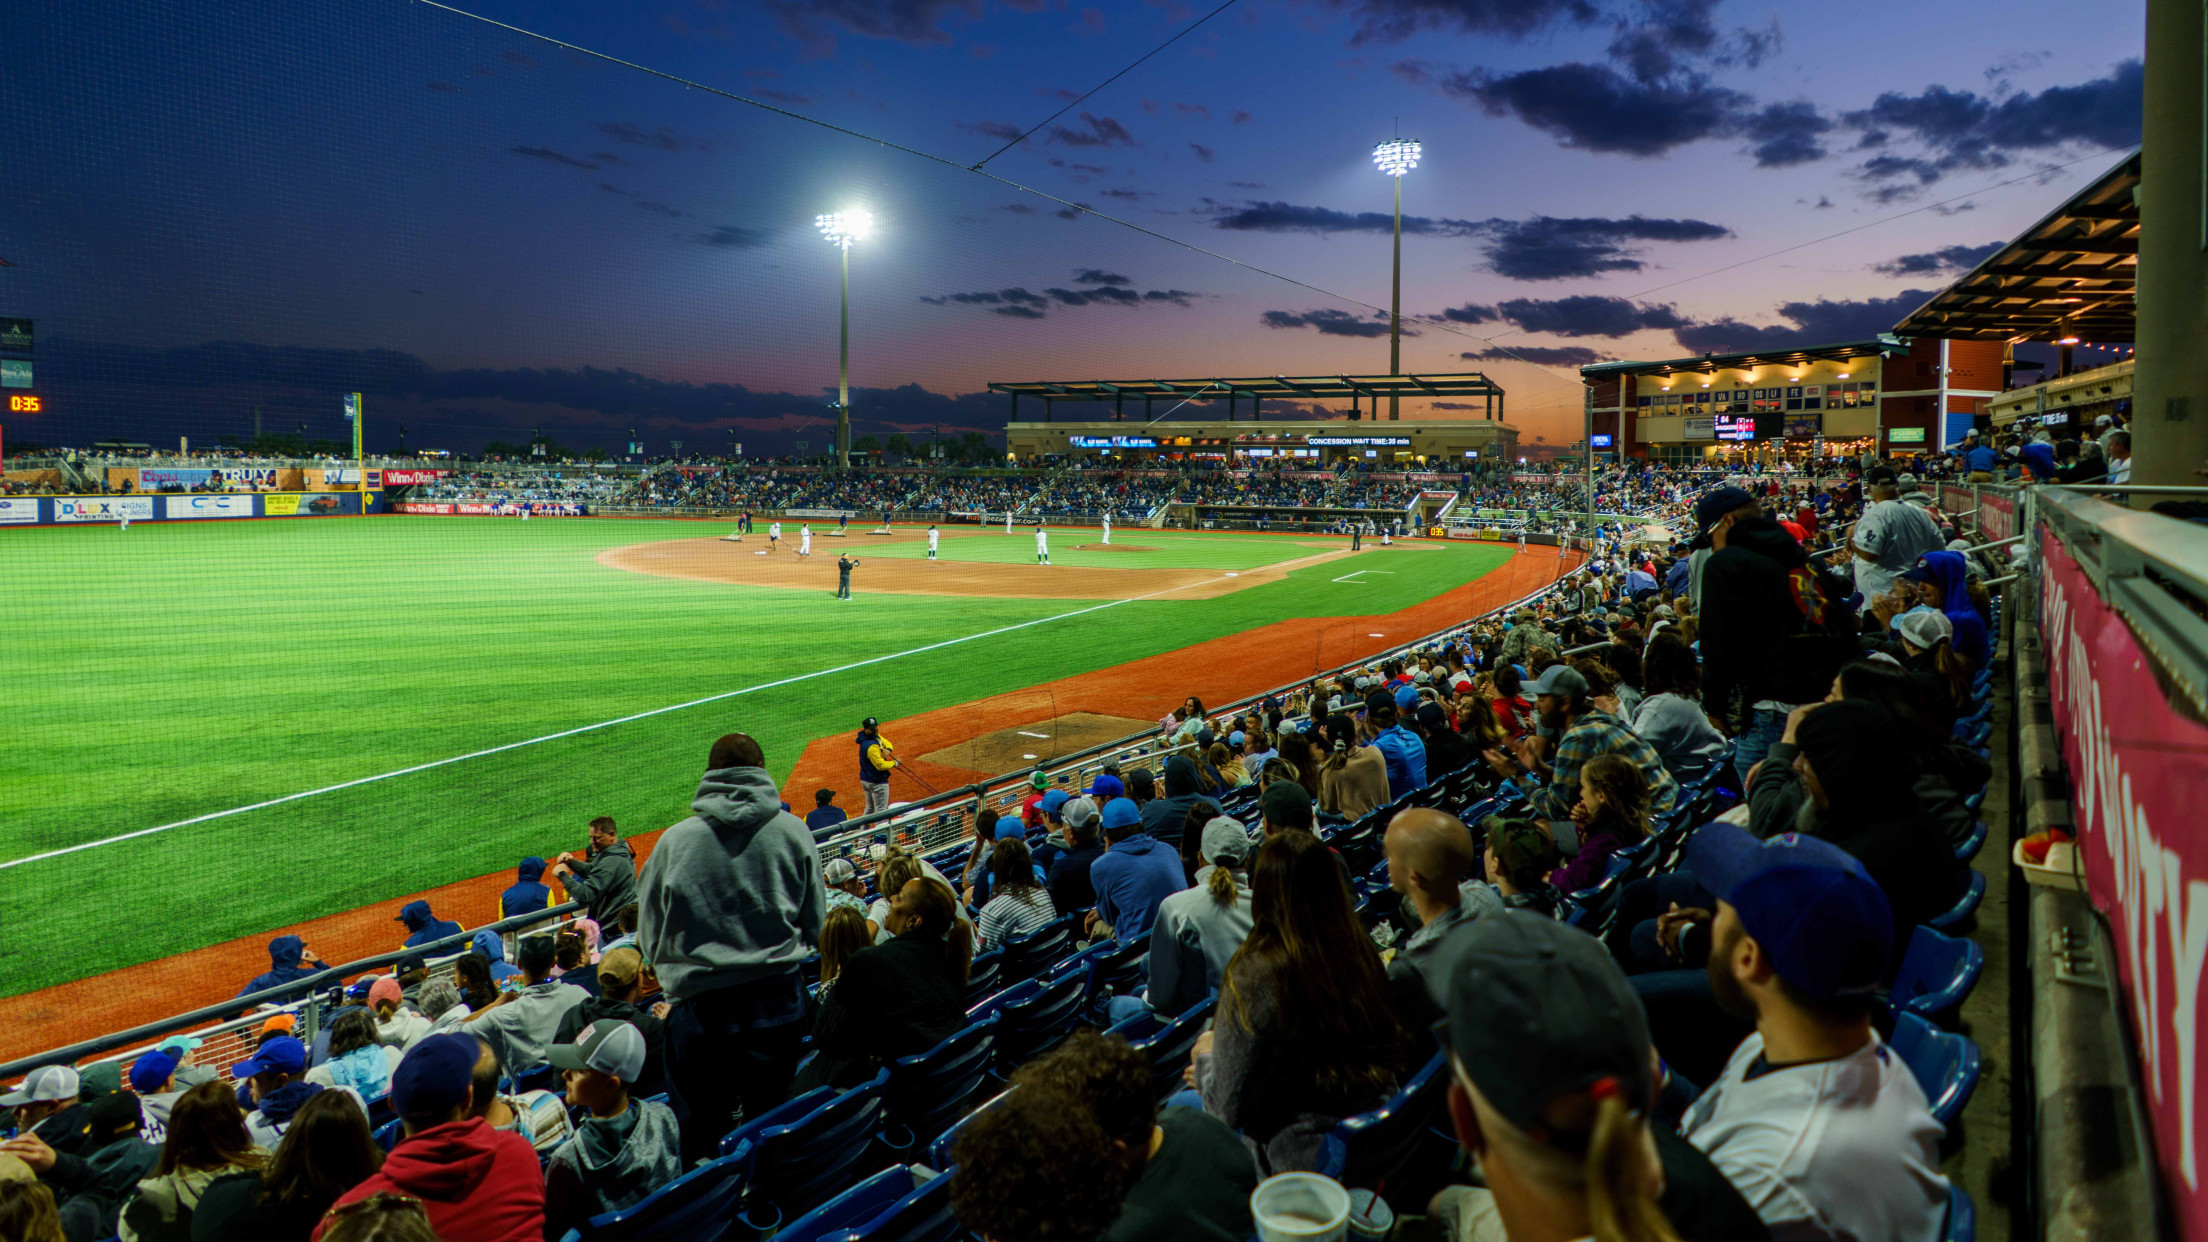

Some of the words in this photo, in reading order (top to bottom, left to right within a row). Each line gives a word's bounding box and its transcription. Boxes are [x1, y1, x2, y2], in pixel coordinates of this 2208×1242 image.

[11, 396, 40, 411] 0:35
[142, 470, 178, 482] Coors
[220, 469, 270, 481] TRULY
[387, 472, 409, 483] Winn
[415, 472, 435, 483] Dixie
[62, 503, 110, 514] DLUX
[121, 502, 147, 510] SIGNS
[396, 504, 413, 513] Winn
